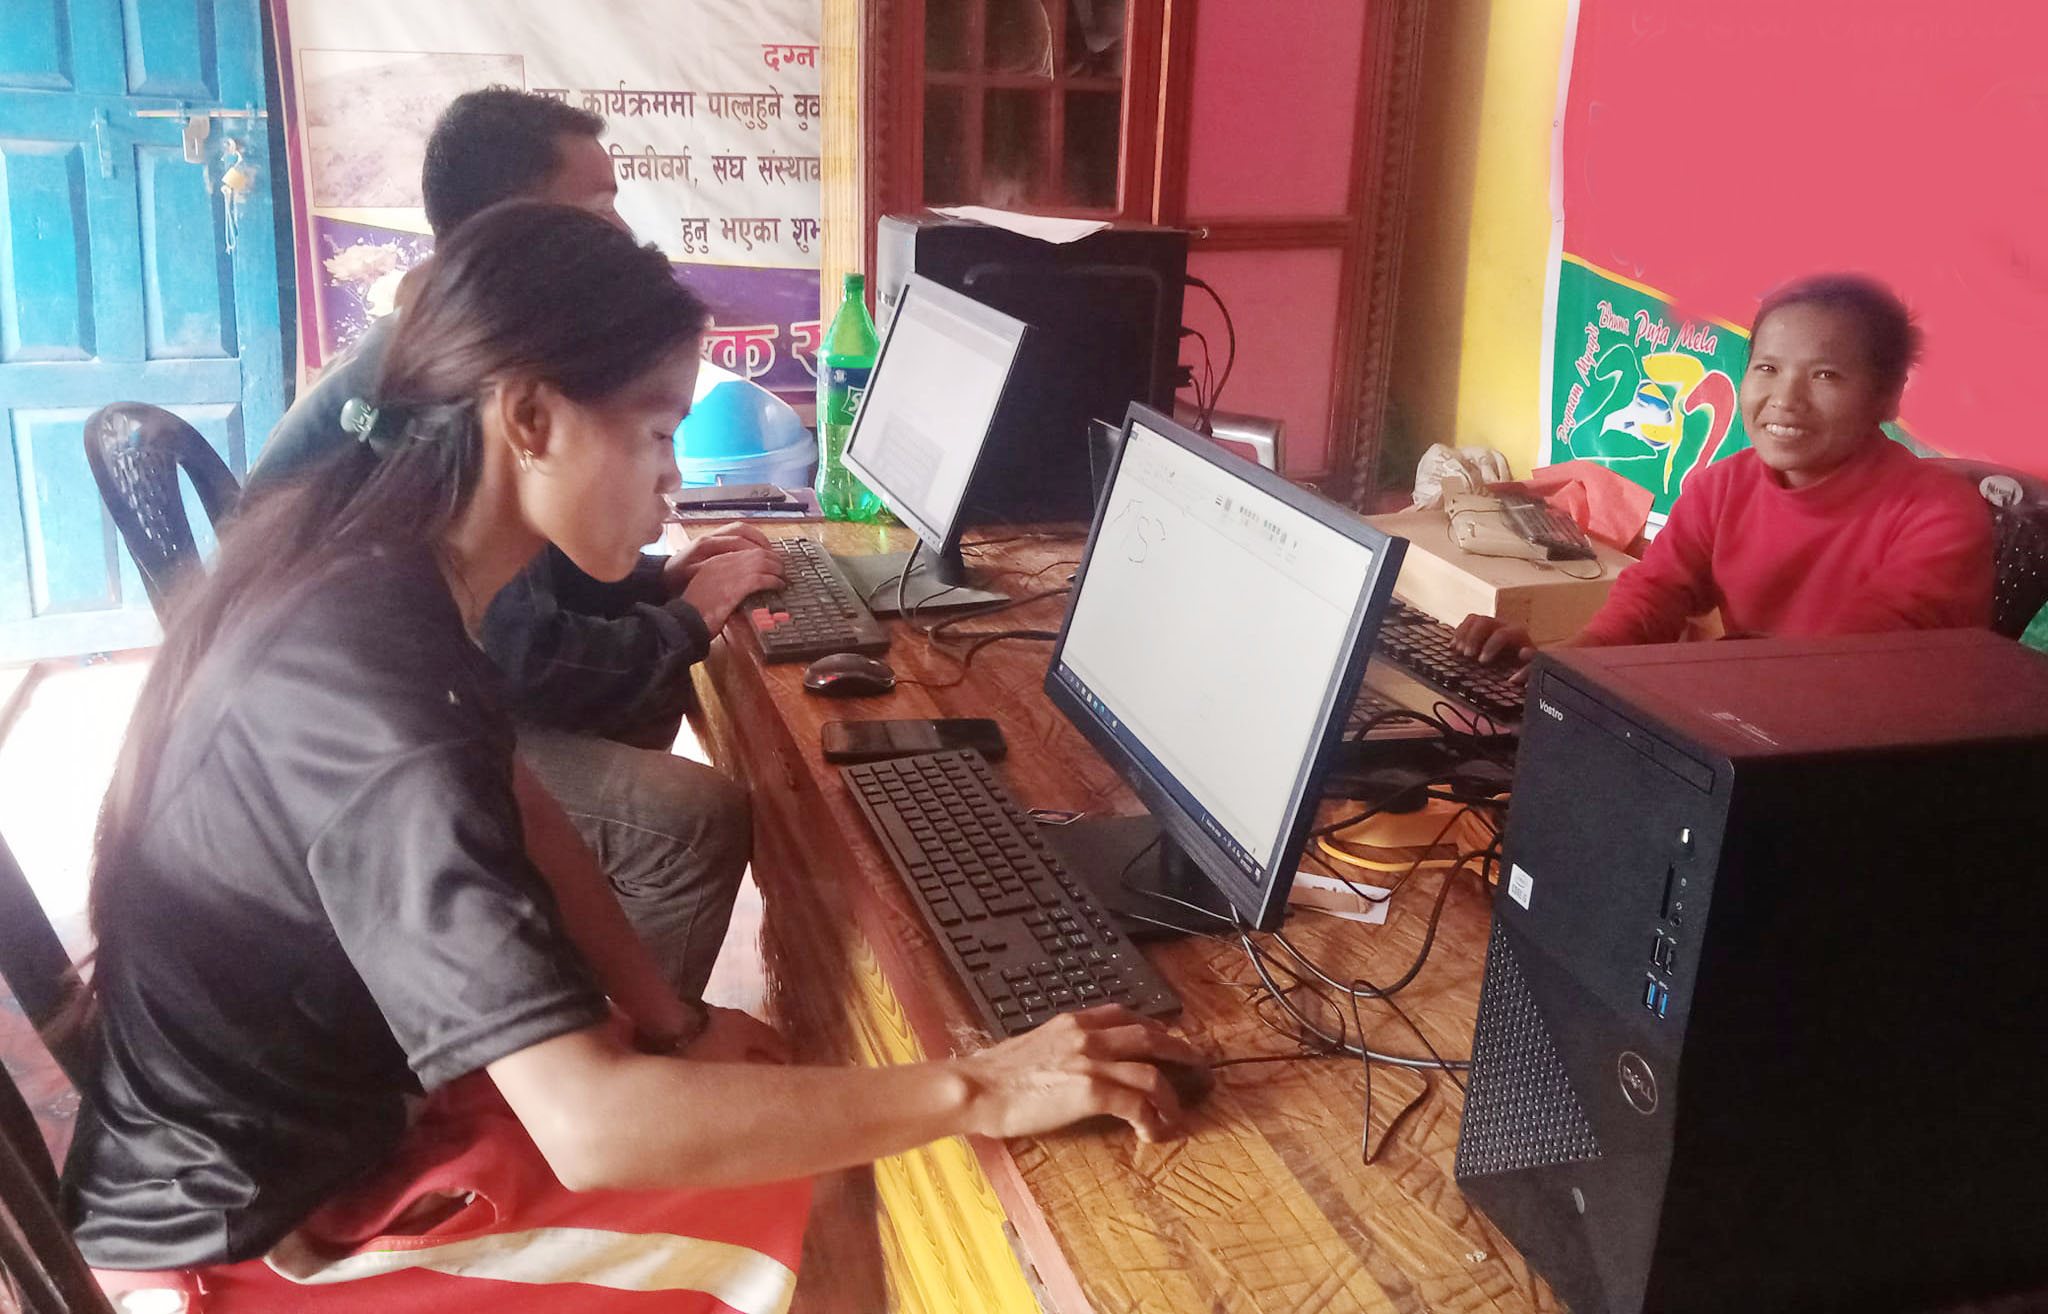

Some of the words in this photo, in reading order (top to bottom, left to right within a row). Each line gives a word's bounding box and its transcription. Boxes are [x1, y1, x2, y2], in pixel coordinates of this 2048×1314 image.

[711, 148, 747, 184] संघ
[720, 218, 781, 249] भएका
[1634, 309, 1670, 352] Puja
[1671, 320, 1718, 356] Mela
[1538, 697, 1564, 721] Vostro
